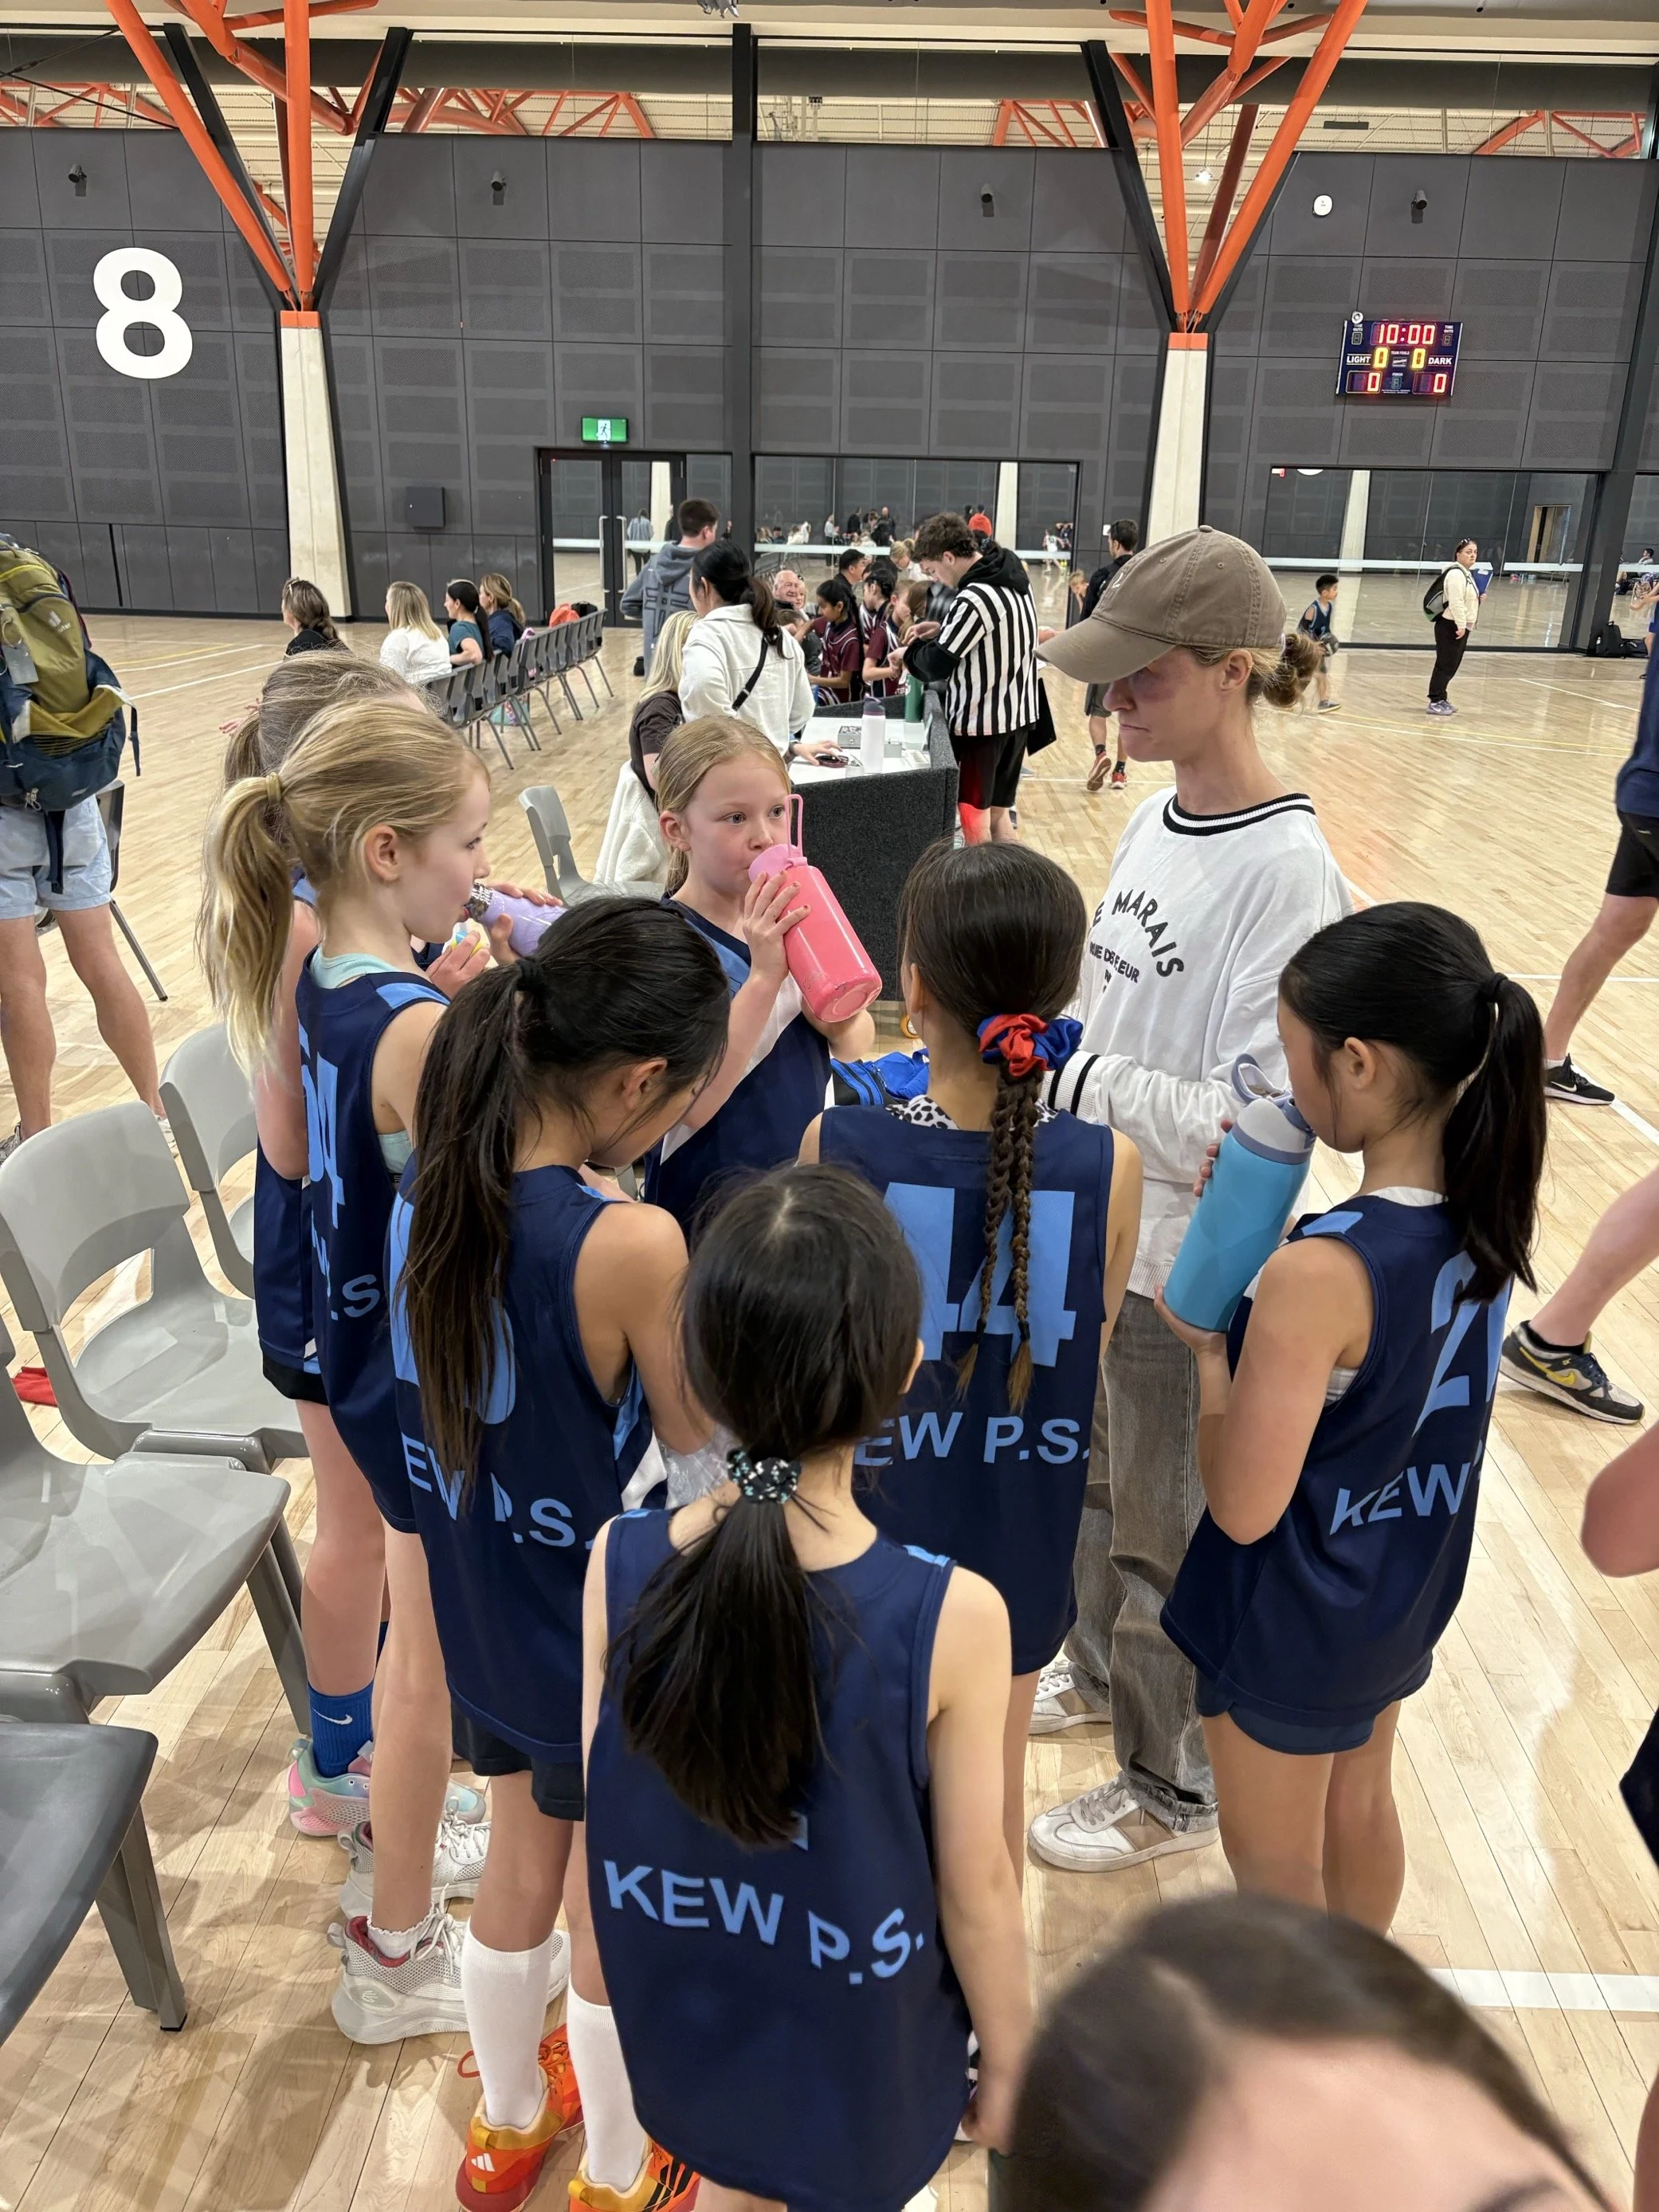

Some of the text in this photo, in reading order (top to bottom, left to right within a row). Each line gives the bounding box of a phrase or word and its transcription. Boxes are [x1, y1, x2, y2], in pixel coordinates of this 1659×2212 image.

[93, 247, 193, 379] 8
[1379, 324, 1435, 345] 10:00
[1367, 372, 1381, 392] 0
[1374, 347, 1389, 368] 0
[1412, 348, 1426, 369] 0
[1433, 374, 1447, 394] 0
[1092, 888, 1185, 978] E MARAIS
[854, 1411, 1090, 1467] EW P.S.
[401, 1432, 466, 1521] EW
[1329, 1461, 1471, 1535] KEW
[604, 1860, 924, 1985] KEW P.S.
